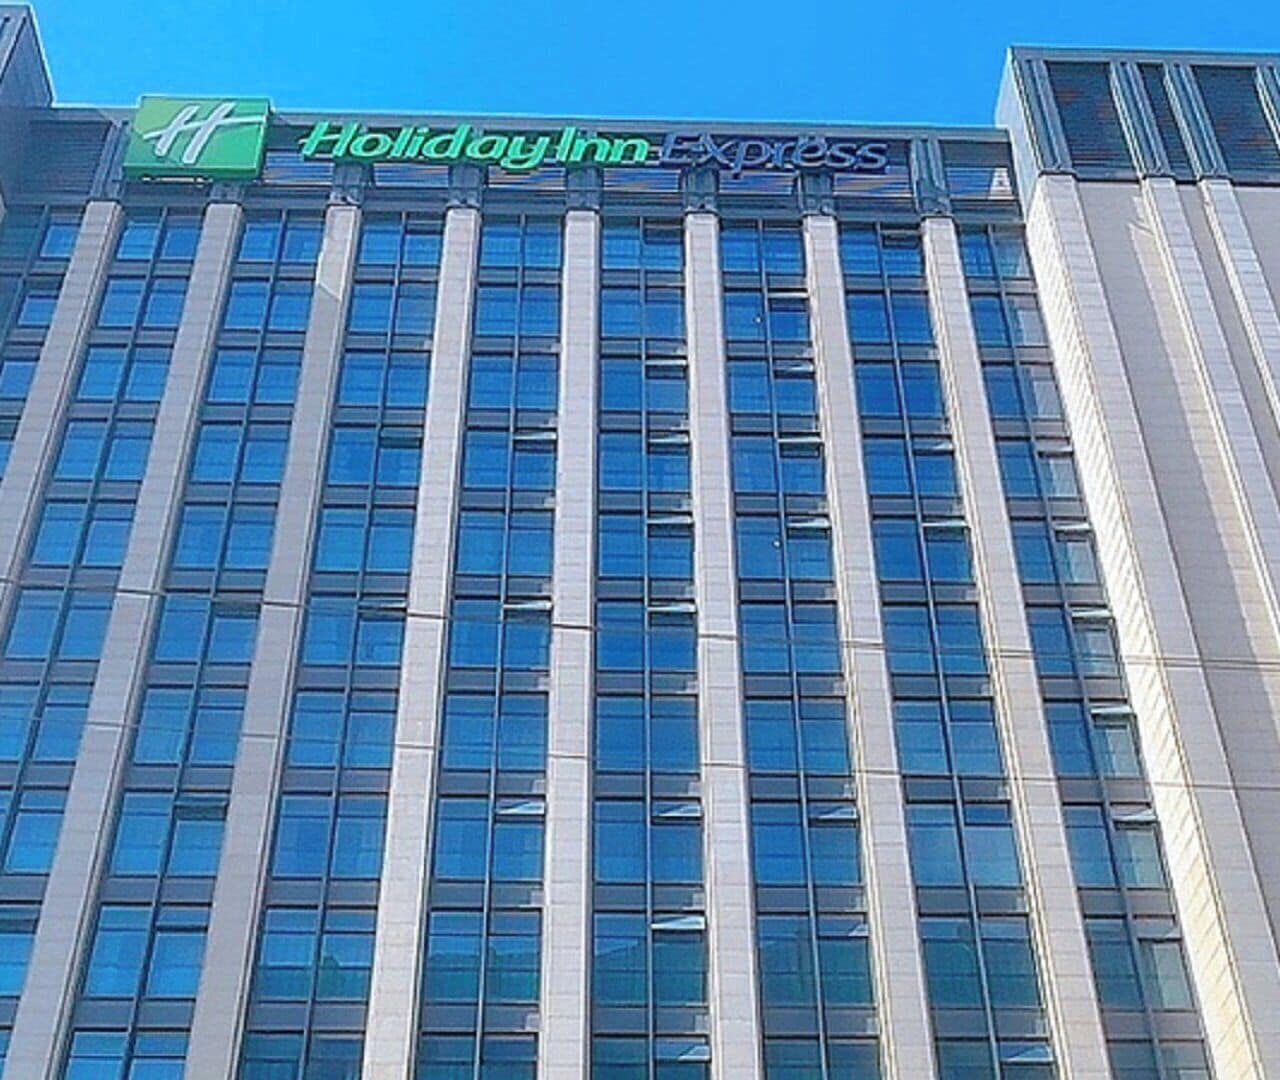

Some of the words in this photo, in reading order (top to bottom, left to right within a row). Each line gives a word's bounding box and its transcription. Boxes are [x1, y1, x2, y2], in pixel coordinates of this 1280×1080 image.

[299, 120, 550, 169] Holiday
[554, 125, 652, 163] Inn
[659, 131, 889, 179] Express
